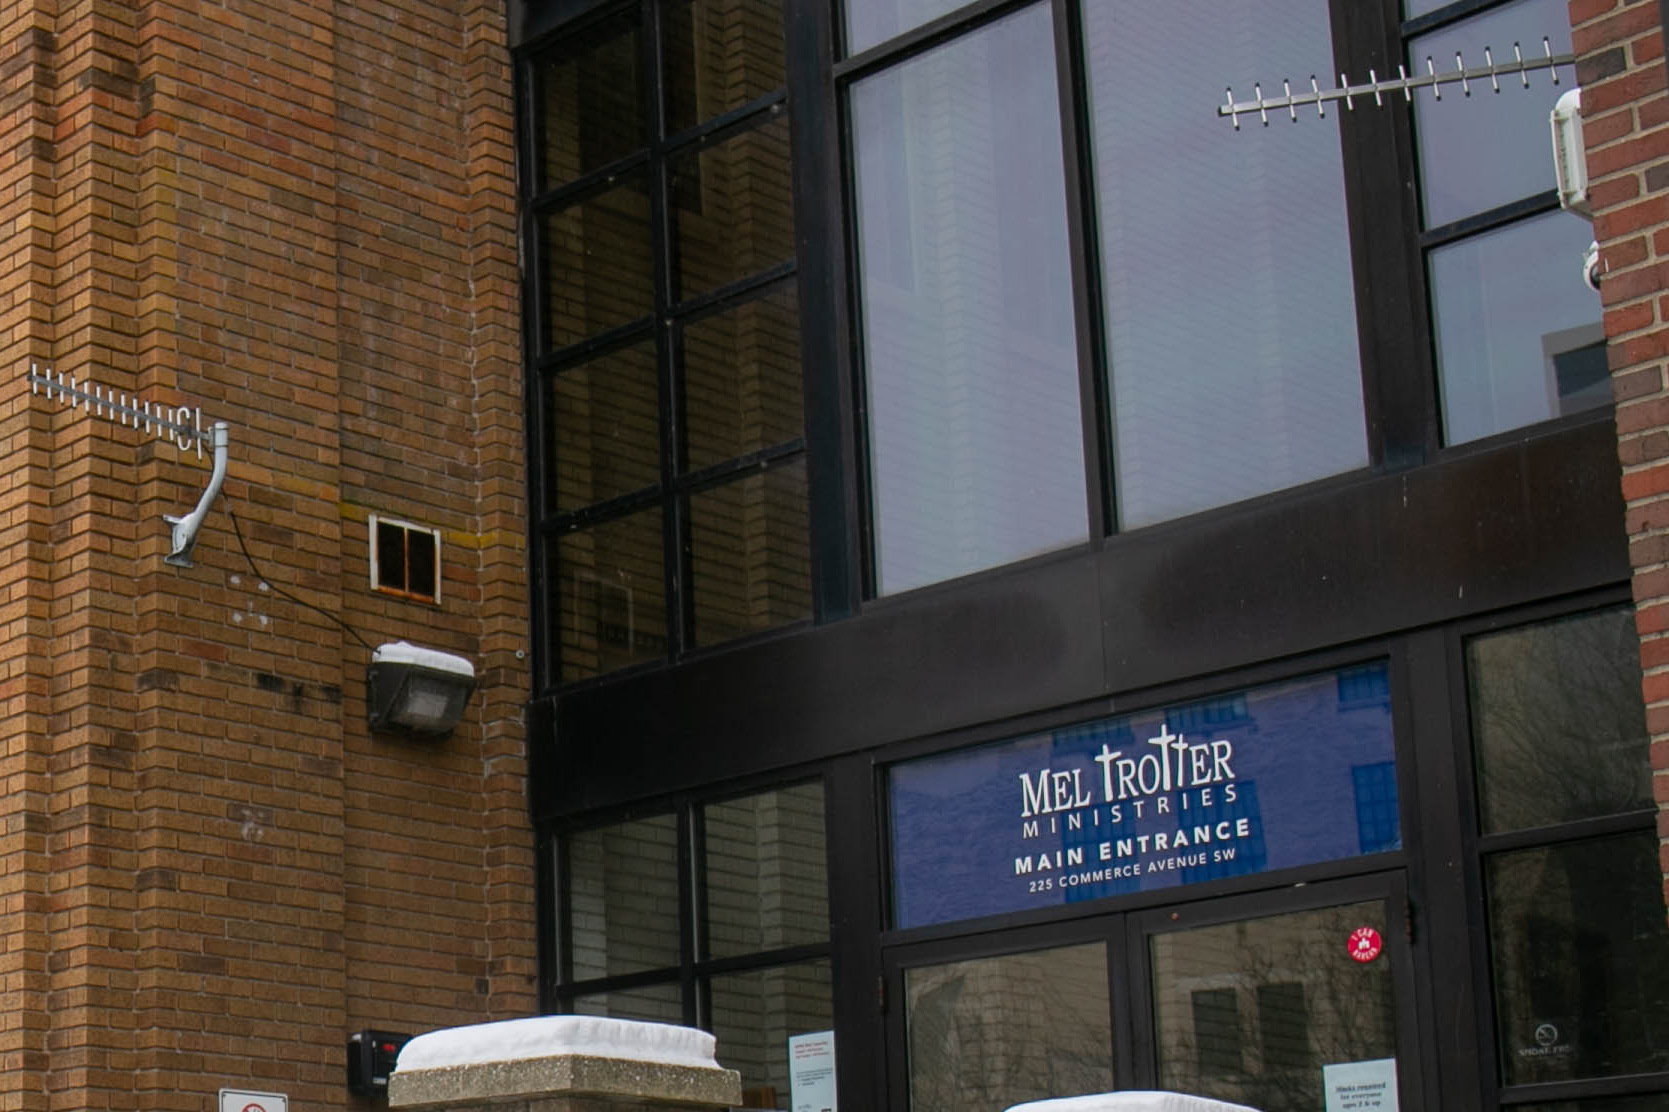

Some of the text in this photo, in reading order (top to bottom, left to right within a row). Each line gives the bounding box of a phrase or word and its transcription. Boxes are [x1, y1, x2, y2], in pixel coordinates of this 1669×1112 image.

[1019, 723, 1235, 817] MEL TROTTER
[1022, 784, 1237, 839] MINISTRIES
[1015, 818, 1250, 875] MAIN ENTRANCE
[1029, 848, 1236, 893] 225 COMMERCE AVENUE SW
